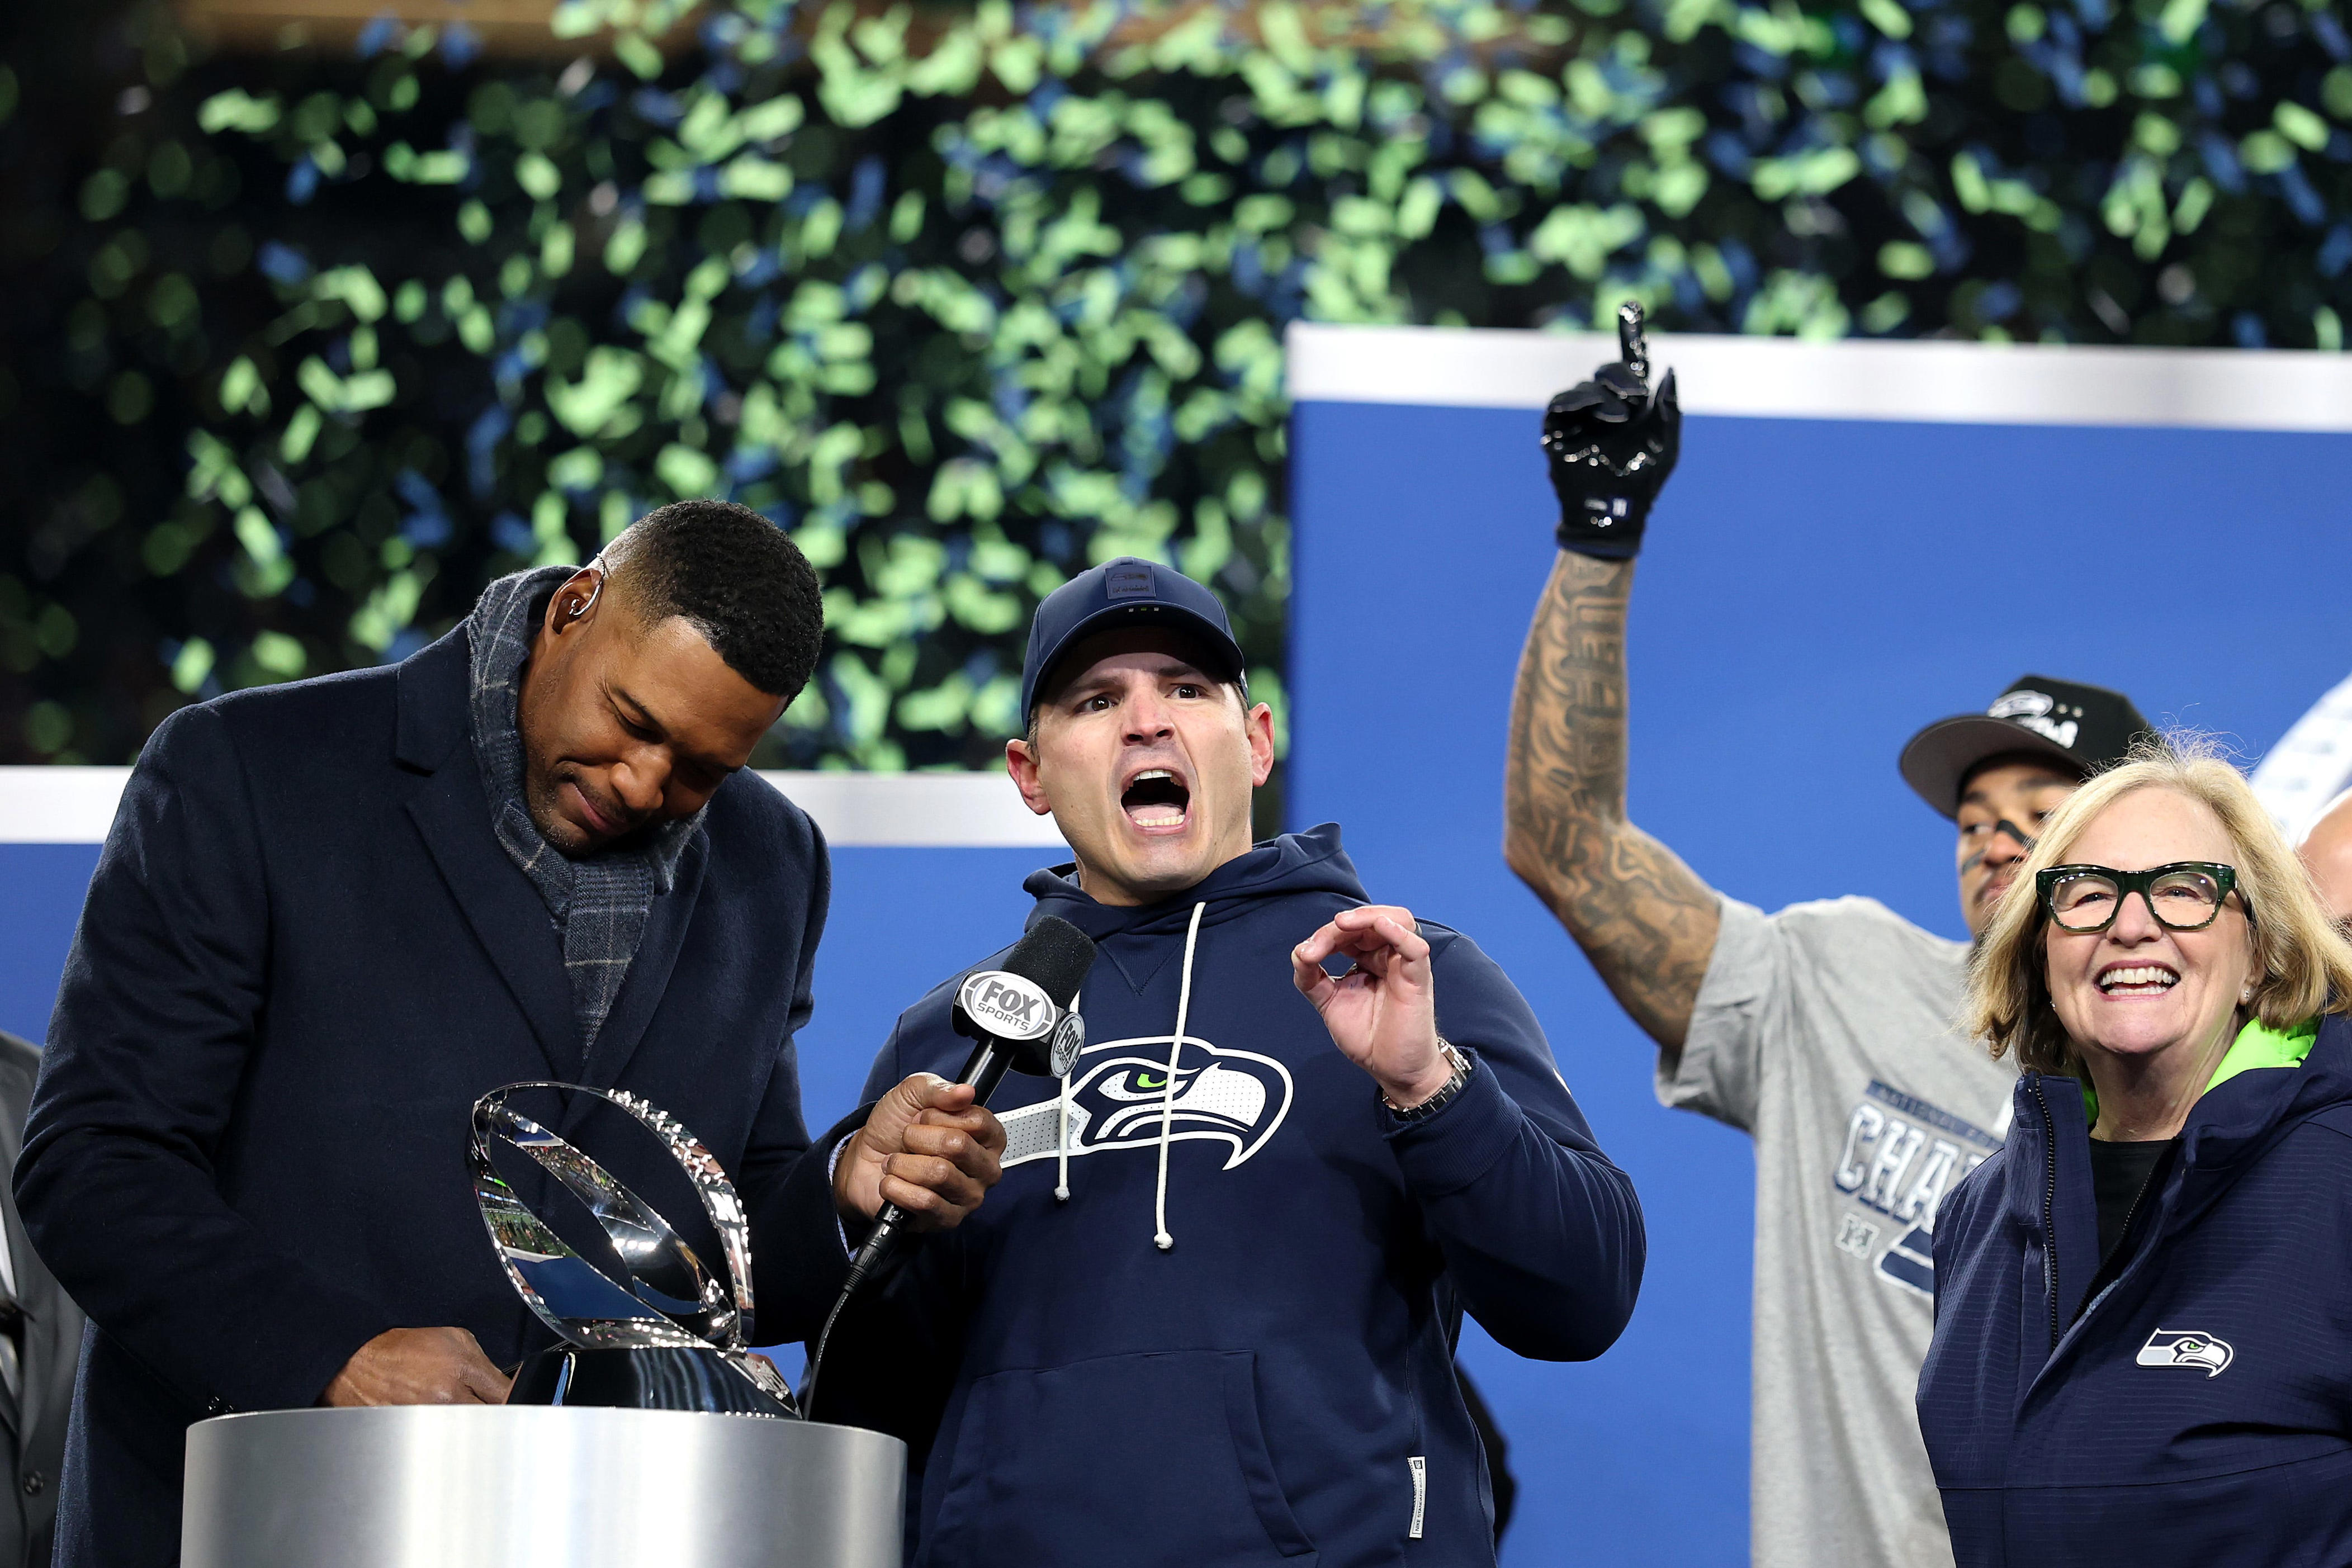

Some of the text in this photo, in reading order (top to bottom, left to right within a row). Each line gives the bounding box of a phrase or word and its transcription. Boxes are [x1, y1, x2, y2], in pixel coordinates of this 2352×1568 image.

[977, 1002, 1030, 1031] SPORTS
[981, 980, 1040, 1021] FOX
[1056, 1044, 1069, 1070] SPORTS
[1061, 1023, 1080, 1061] FOX
[1834, 1103, 1987, 1232] CHA
